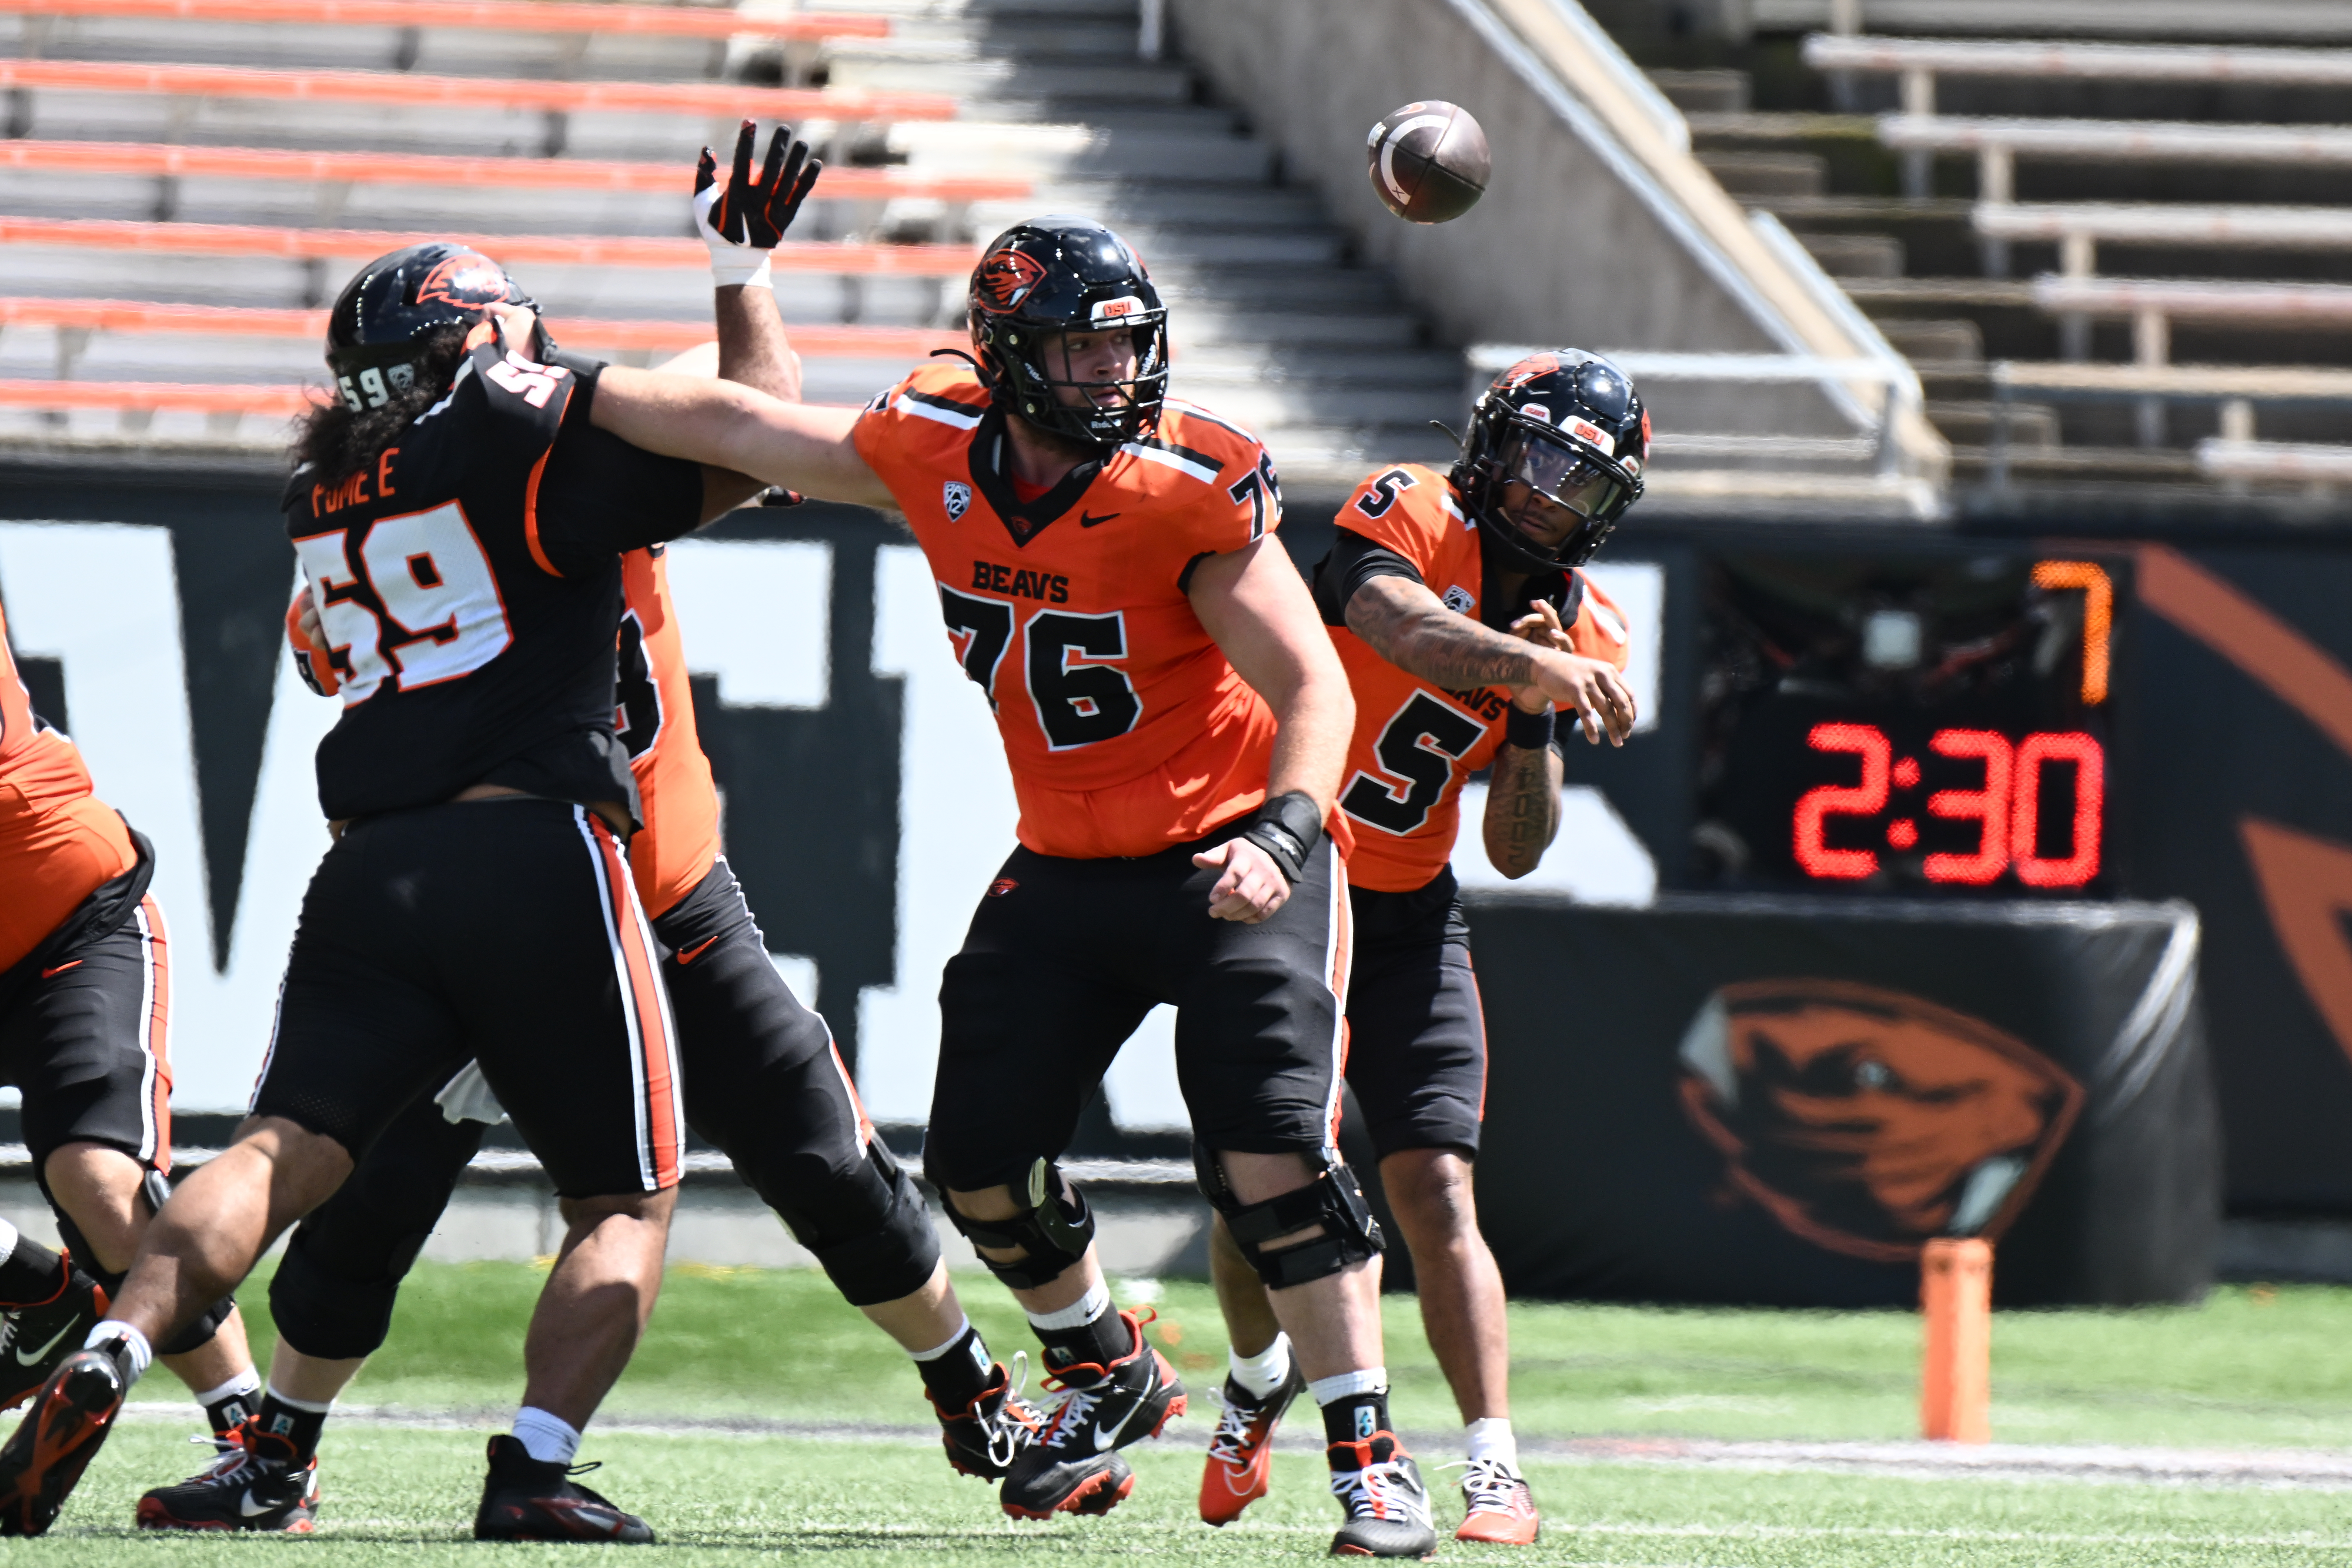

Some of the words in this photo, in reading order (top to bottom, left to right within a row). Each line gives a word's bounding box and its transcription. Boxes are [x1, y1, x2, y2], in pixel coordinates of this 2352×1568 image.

[338, 366, 389, 412] 59
[1574, 422, 1605, 446] OSU
[1354, 467, 1421, 520] 5
[293, 498, 514, 709] 59
[972, 560, 1069, 604] BEAVS
[2031, 560, 2113, 705] 7
[938, 580, 1144, 752] 76
[1339, 688, 1487, 836] 5
[1793, 723, 2104, 888] 2:30
